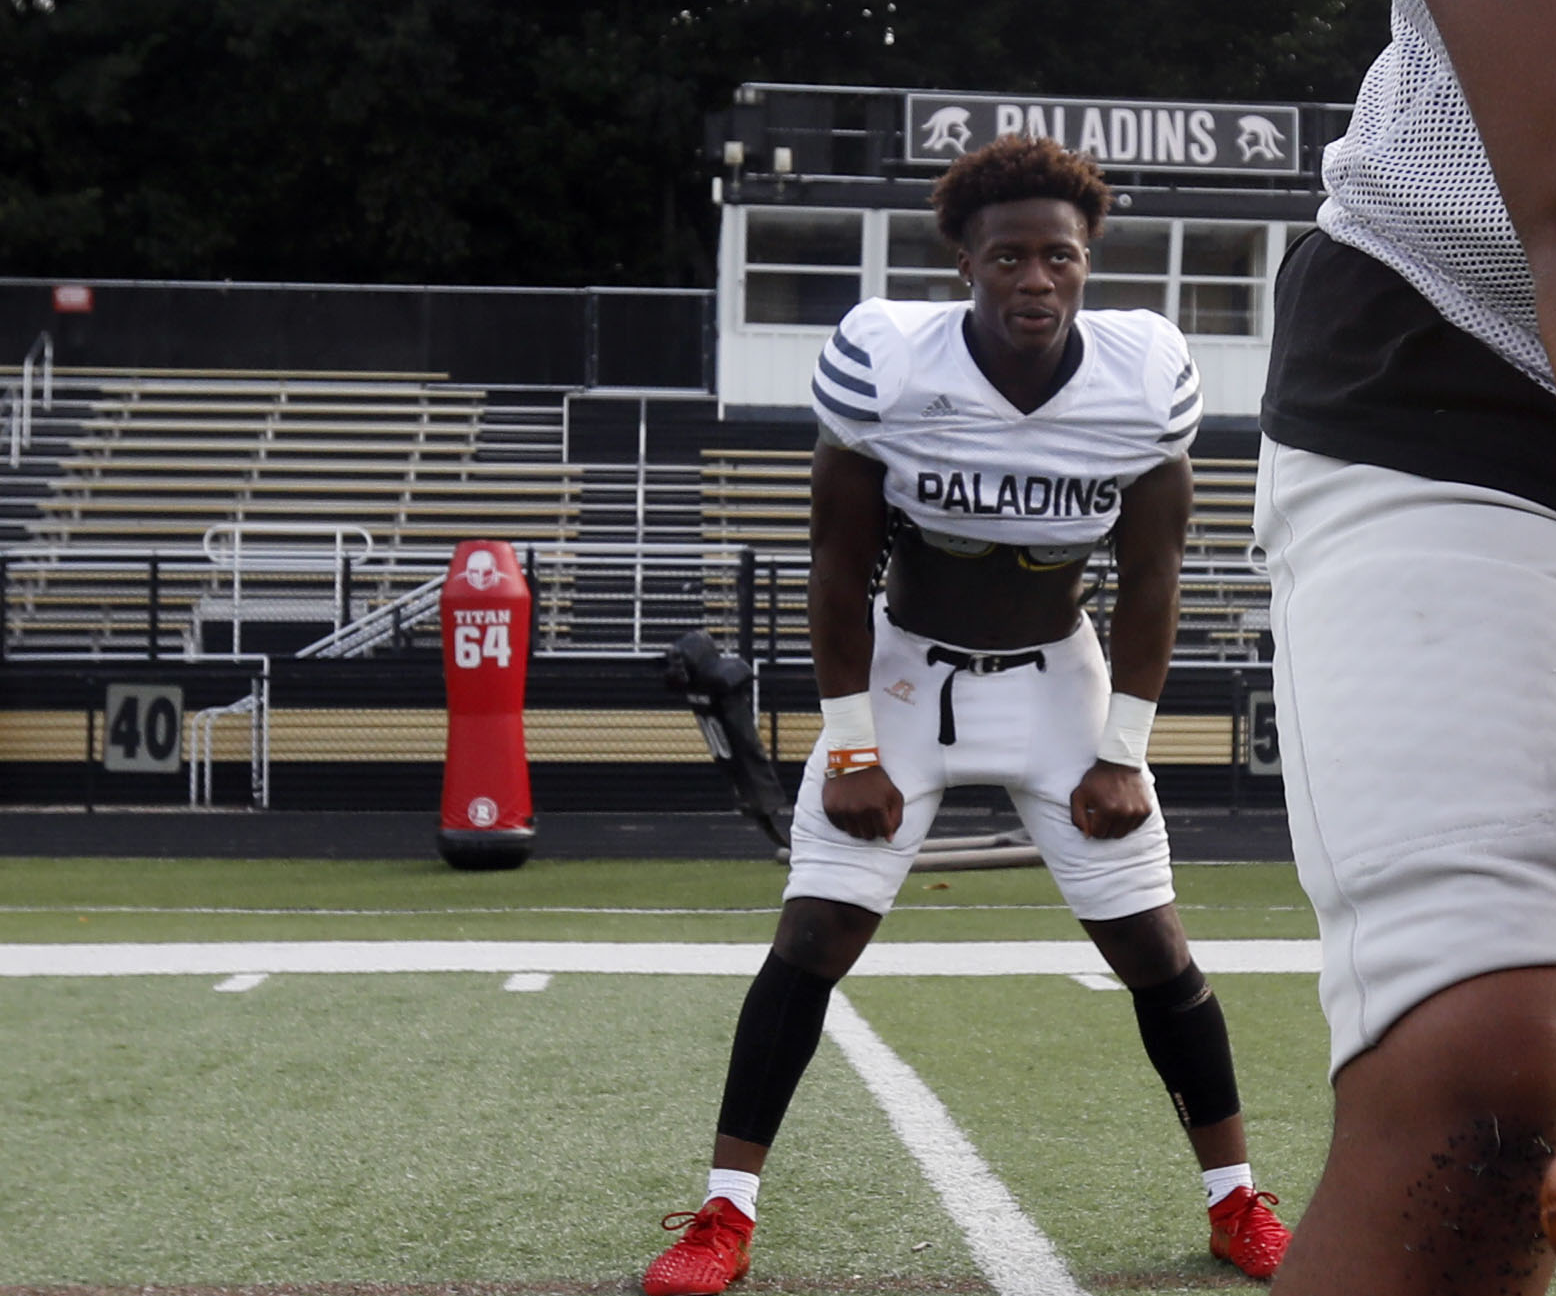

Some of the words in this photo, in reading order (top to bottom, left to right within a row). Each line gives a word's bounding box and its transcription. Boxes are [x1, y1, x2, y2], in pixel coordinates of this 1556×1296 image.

[917, 471, 1119, 516] PALADINS
[453, 609, 511, 624] TITAN
[454, 624, 511, 669] 64
[110, 695, 178, 761] 40
[1253, 702, 1280, 764] 5
